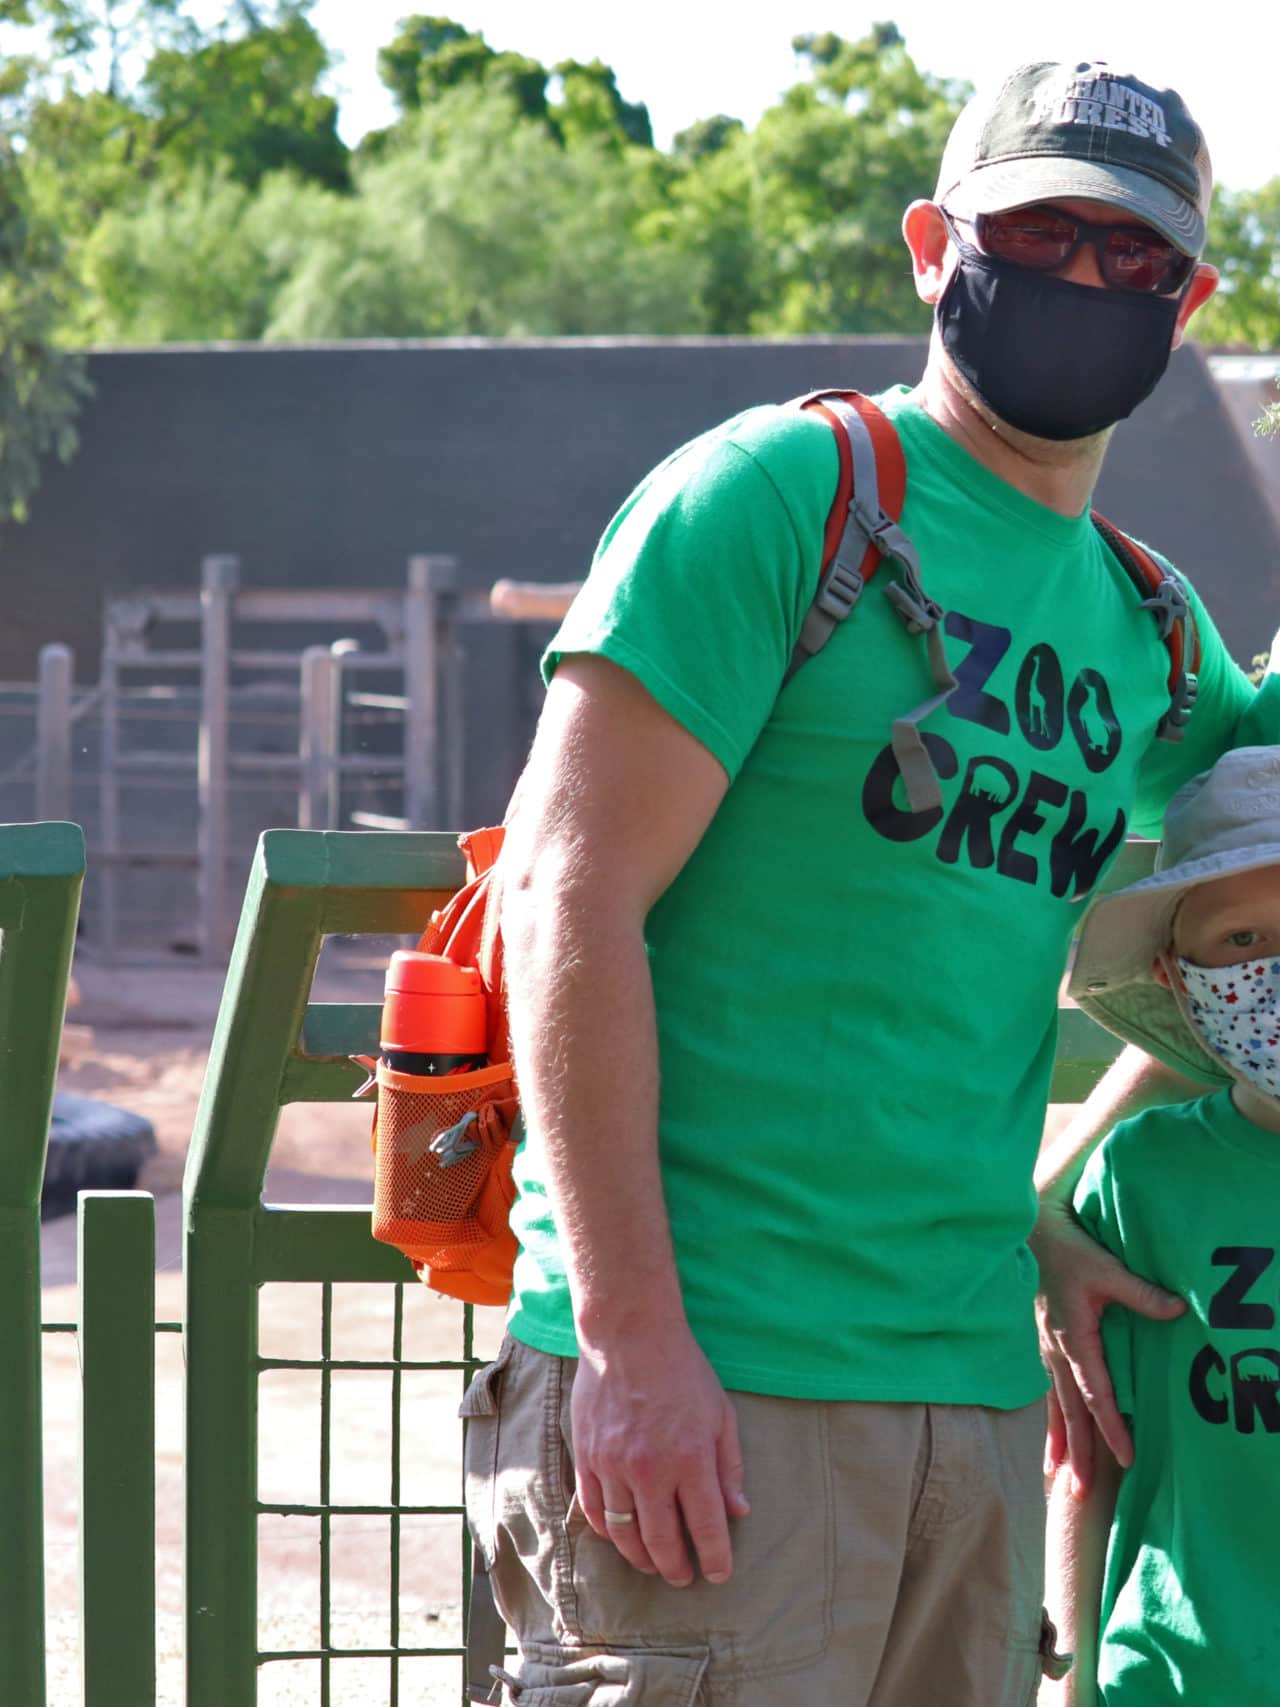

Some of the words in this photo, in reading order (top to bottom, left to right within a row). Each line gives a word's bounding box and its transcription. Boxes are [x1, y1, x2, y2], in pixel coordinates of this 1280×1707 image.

[1033, 80, 1167, 132] HANTED
[944, 610, 1122, 773] ZOO
[862, 732, 1125, 903] CREW
